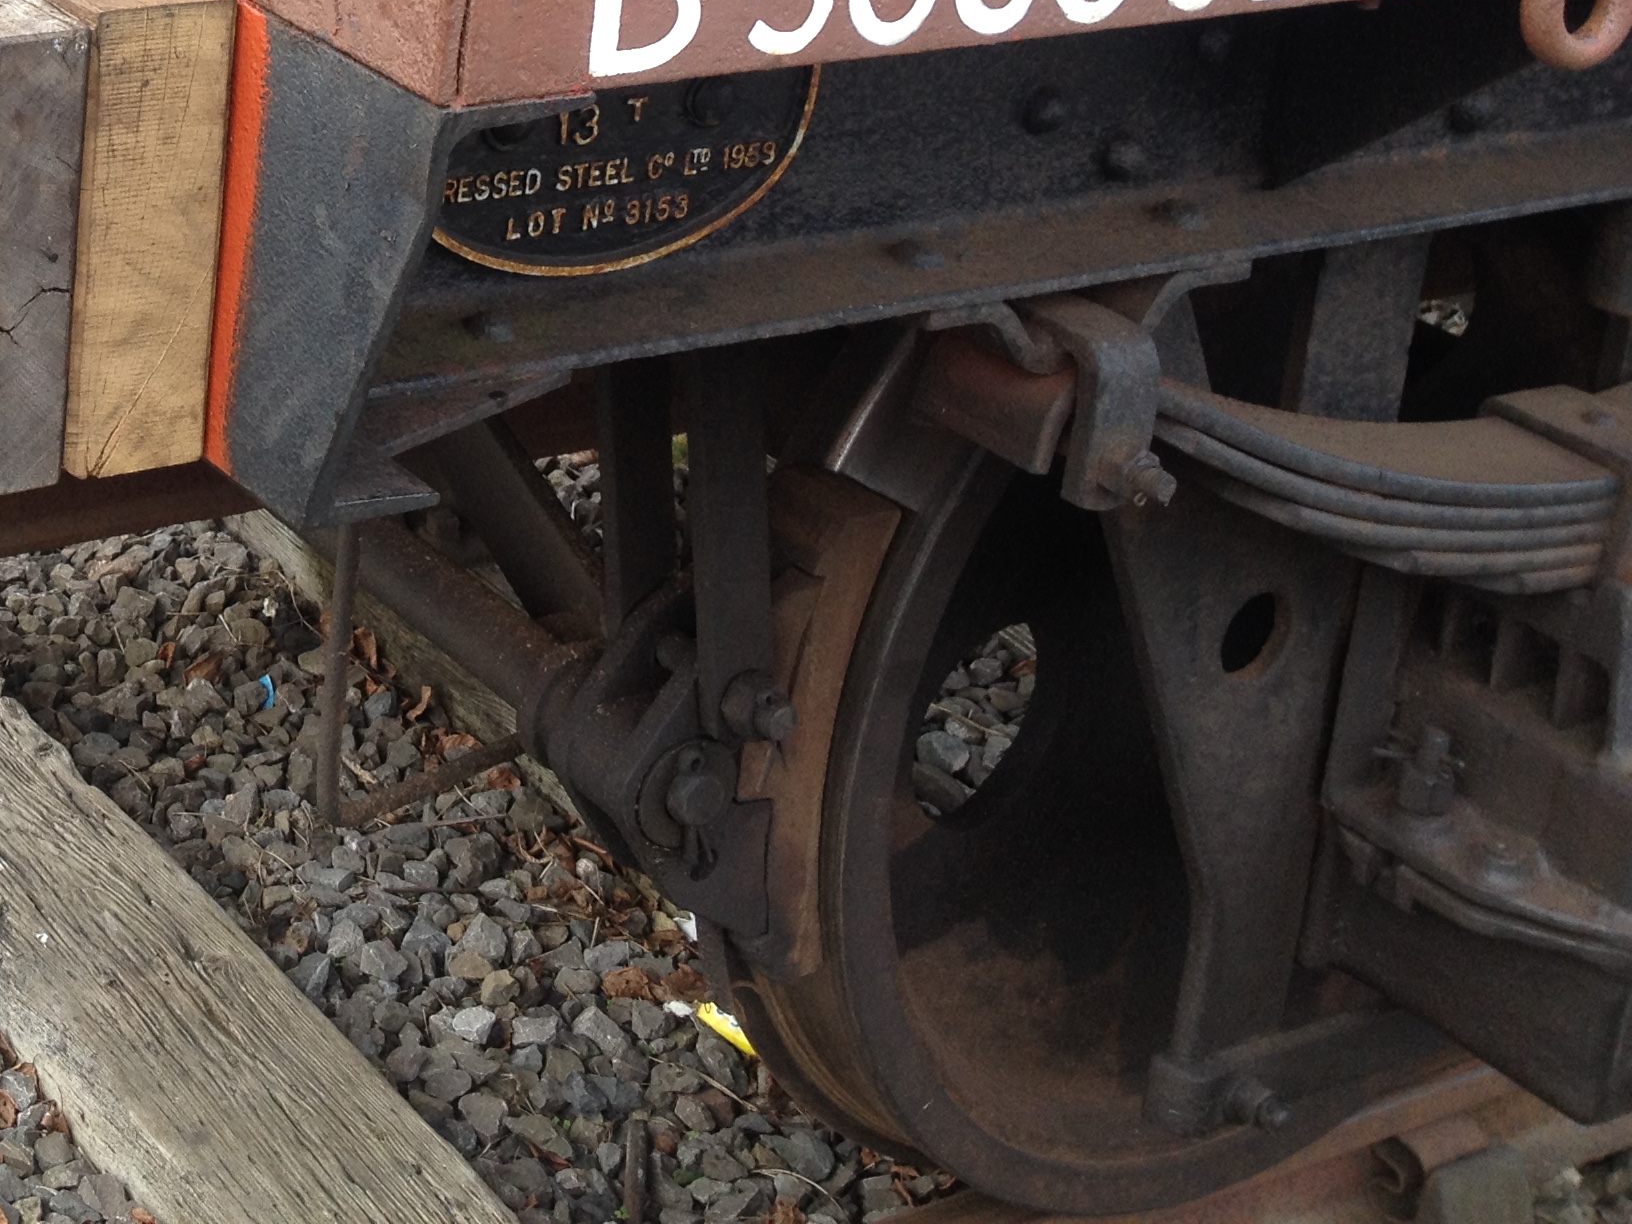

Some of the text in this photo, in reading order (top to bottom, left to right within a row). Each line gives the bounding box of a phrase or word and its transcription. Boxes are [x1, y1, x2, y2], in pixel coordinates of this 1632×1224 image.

[559, 97, 649, 146] 13 T
[555, 157, 634, 192] STEEL
[506, 207, 566, 241] LOT
[626, 193, 690, 226] 3153
